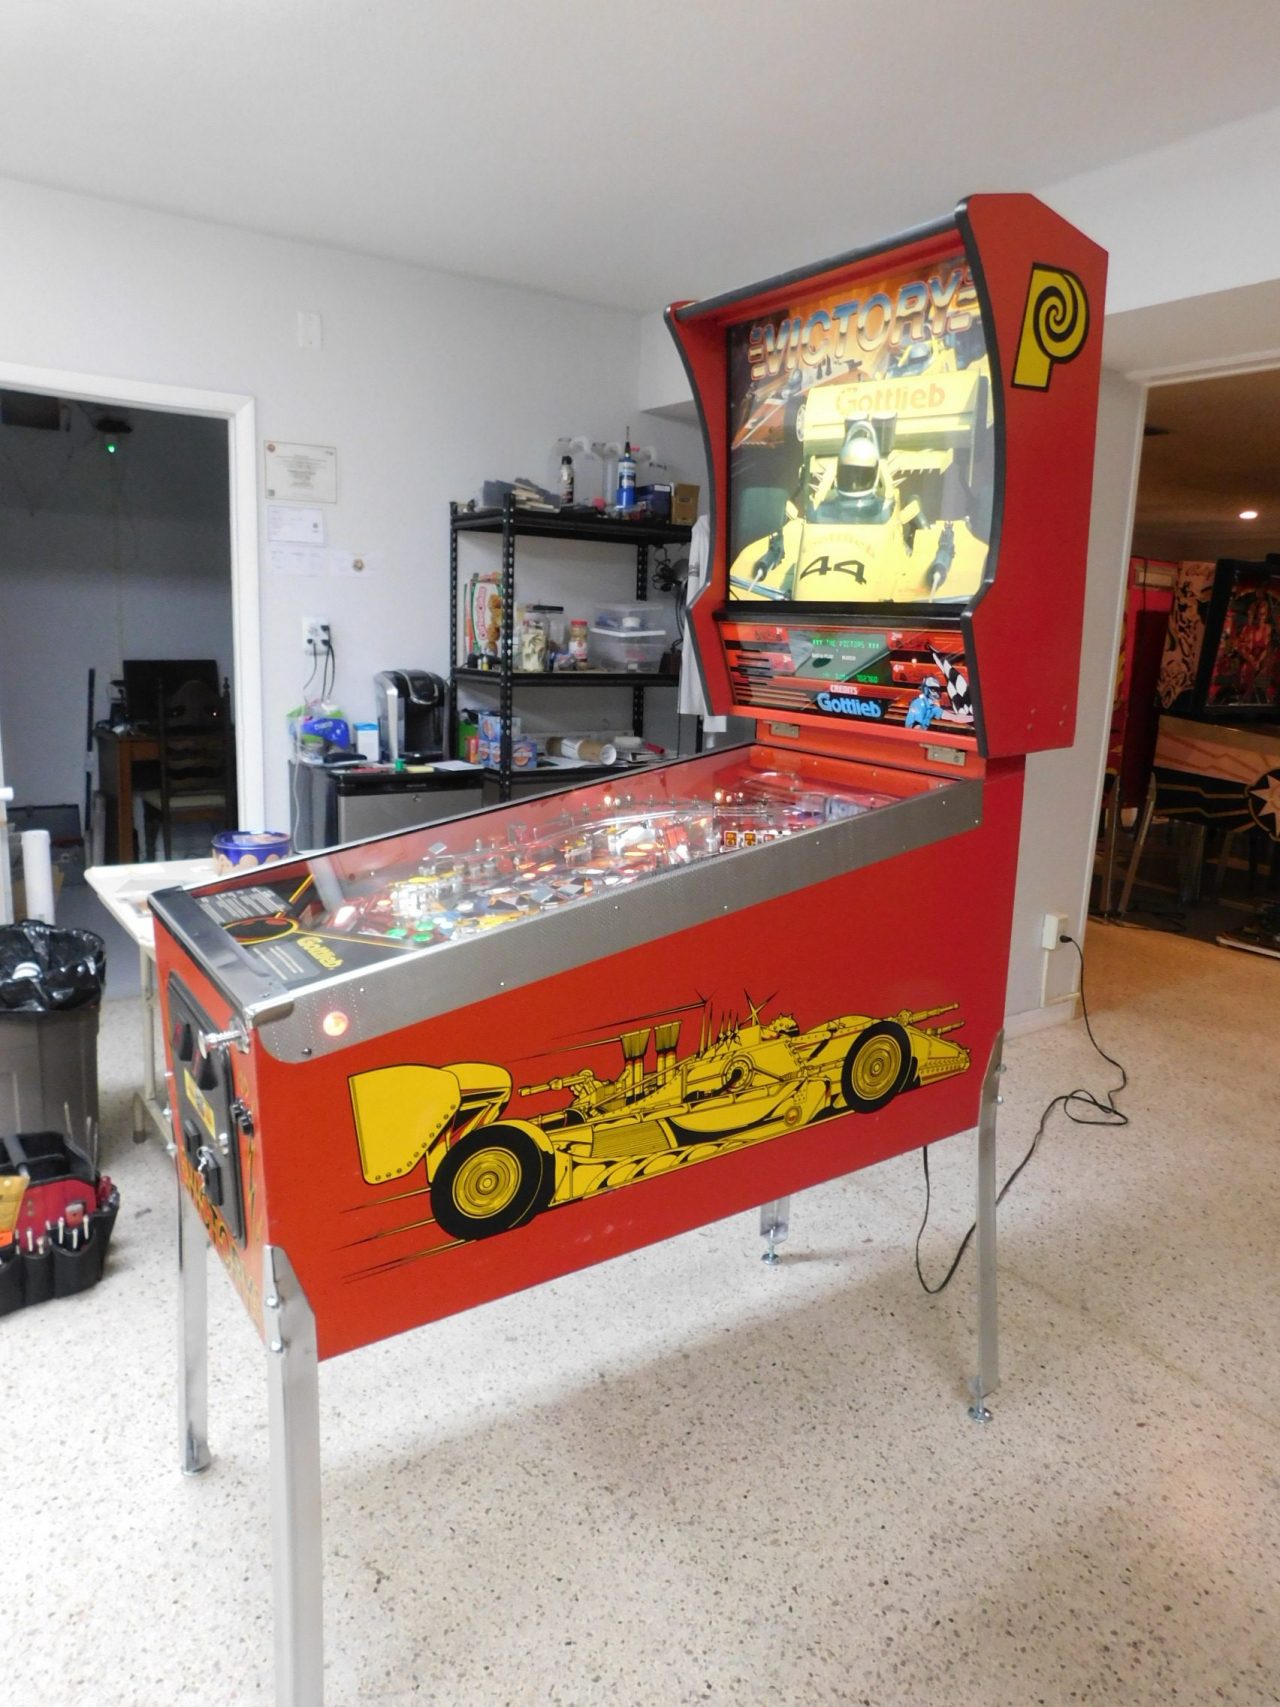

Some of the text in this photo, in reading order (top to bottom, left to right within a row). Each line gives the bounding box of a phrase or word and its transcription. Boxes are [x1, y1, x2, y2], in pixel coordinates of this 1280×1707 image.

[763, 269, 964, 377] VICTORY
[836, 383, 946, 415] Gottlieb
[817, 692, 881, 718] Gottlieb
